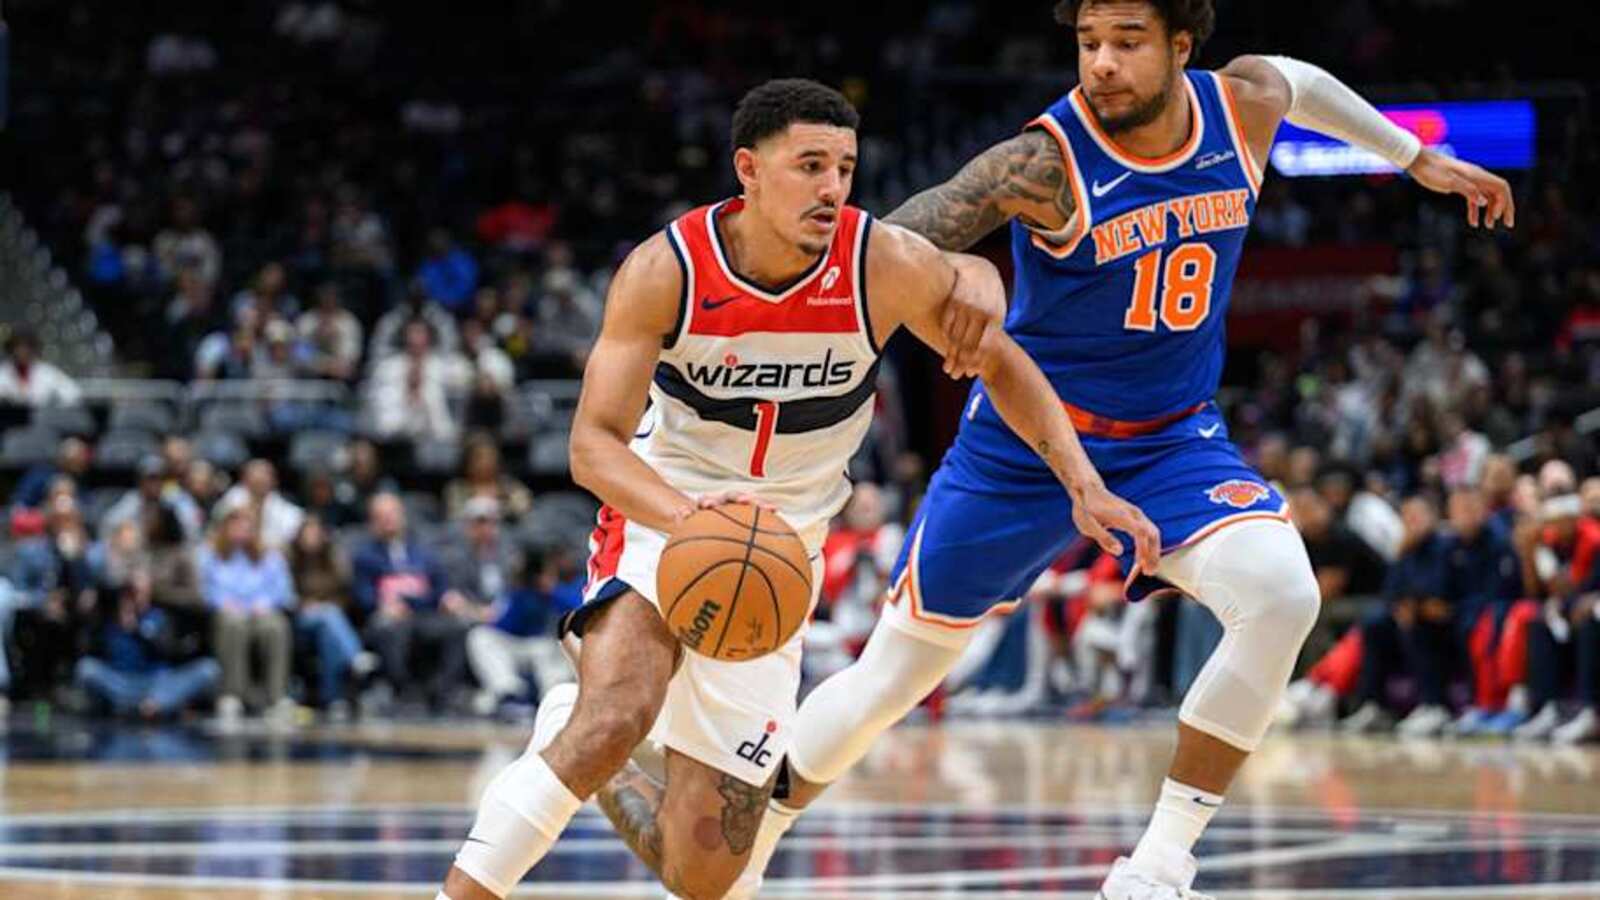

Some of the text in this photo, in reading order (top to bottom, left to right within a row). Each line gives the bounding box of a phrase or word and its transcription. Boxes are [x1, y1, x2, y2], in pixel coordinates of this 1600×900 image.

[1091, 188, 1249, 266] NEW YORK
[1123, 242, 1217, 332] 18
[686, 348, 856, 389] wizards
[749, 399, 779, 478] 1
[736, 719, 777, 768] dc
